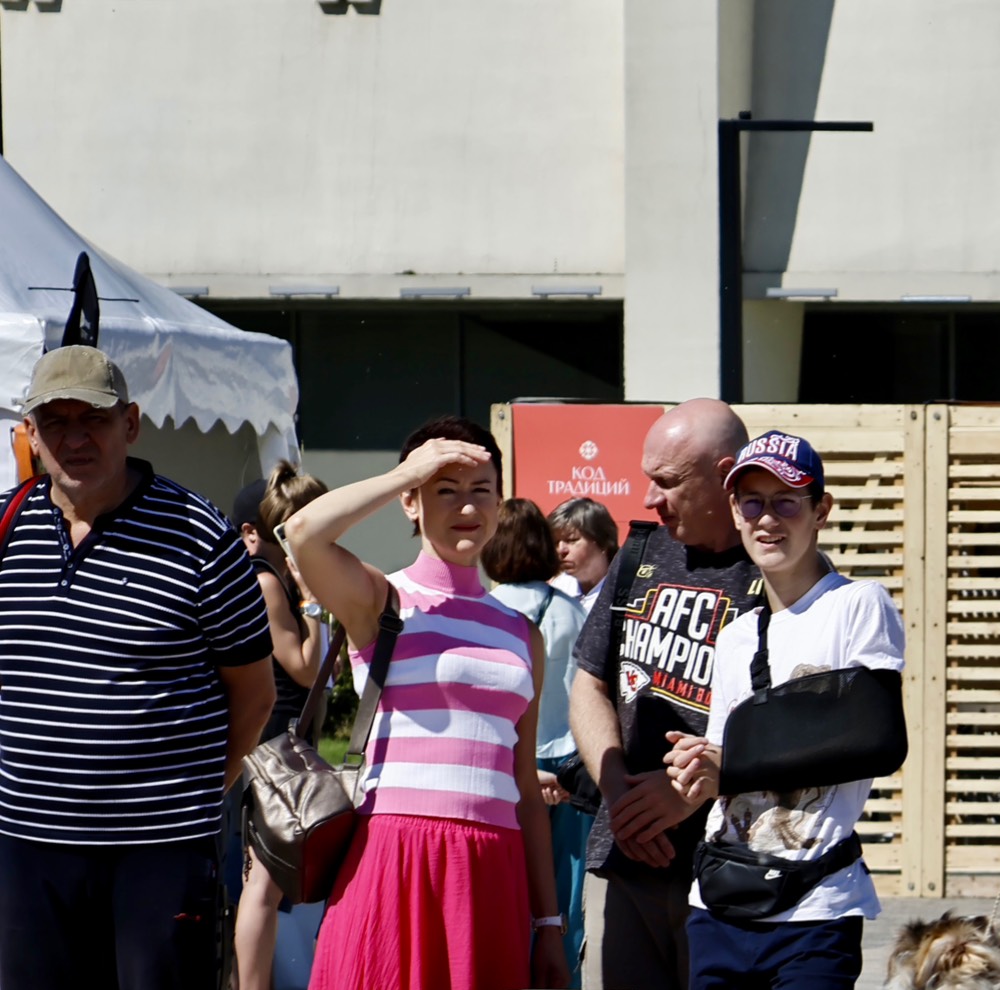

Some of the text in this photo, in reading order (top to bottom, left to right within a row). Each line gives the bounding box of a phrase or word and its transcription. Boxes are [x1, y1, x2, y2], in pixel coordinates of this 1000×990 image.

[571, 466, 606, 480] КОД
[547, 478, 630, 496] ТРАДИЦИЙ
[650, 588, 716, 641] AFC
[652, 670, 694, 699] MIAMI
